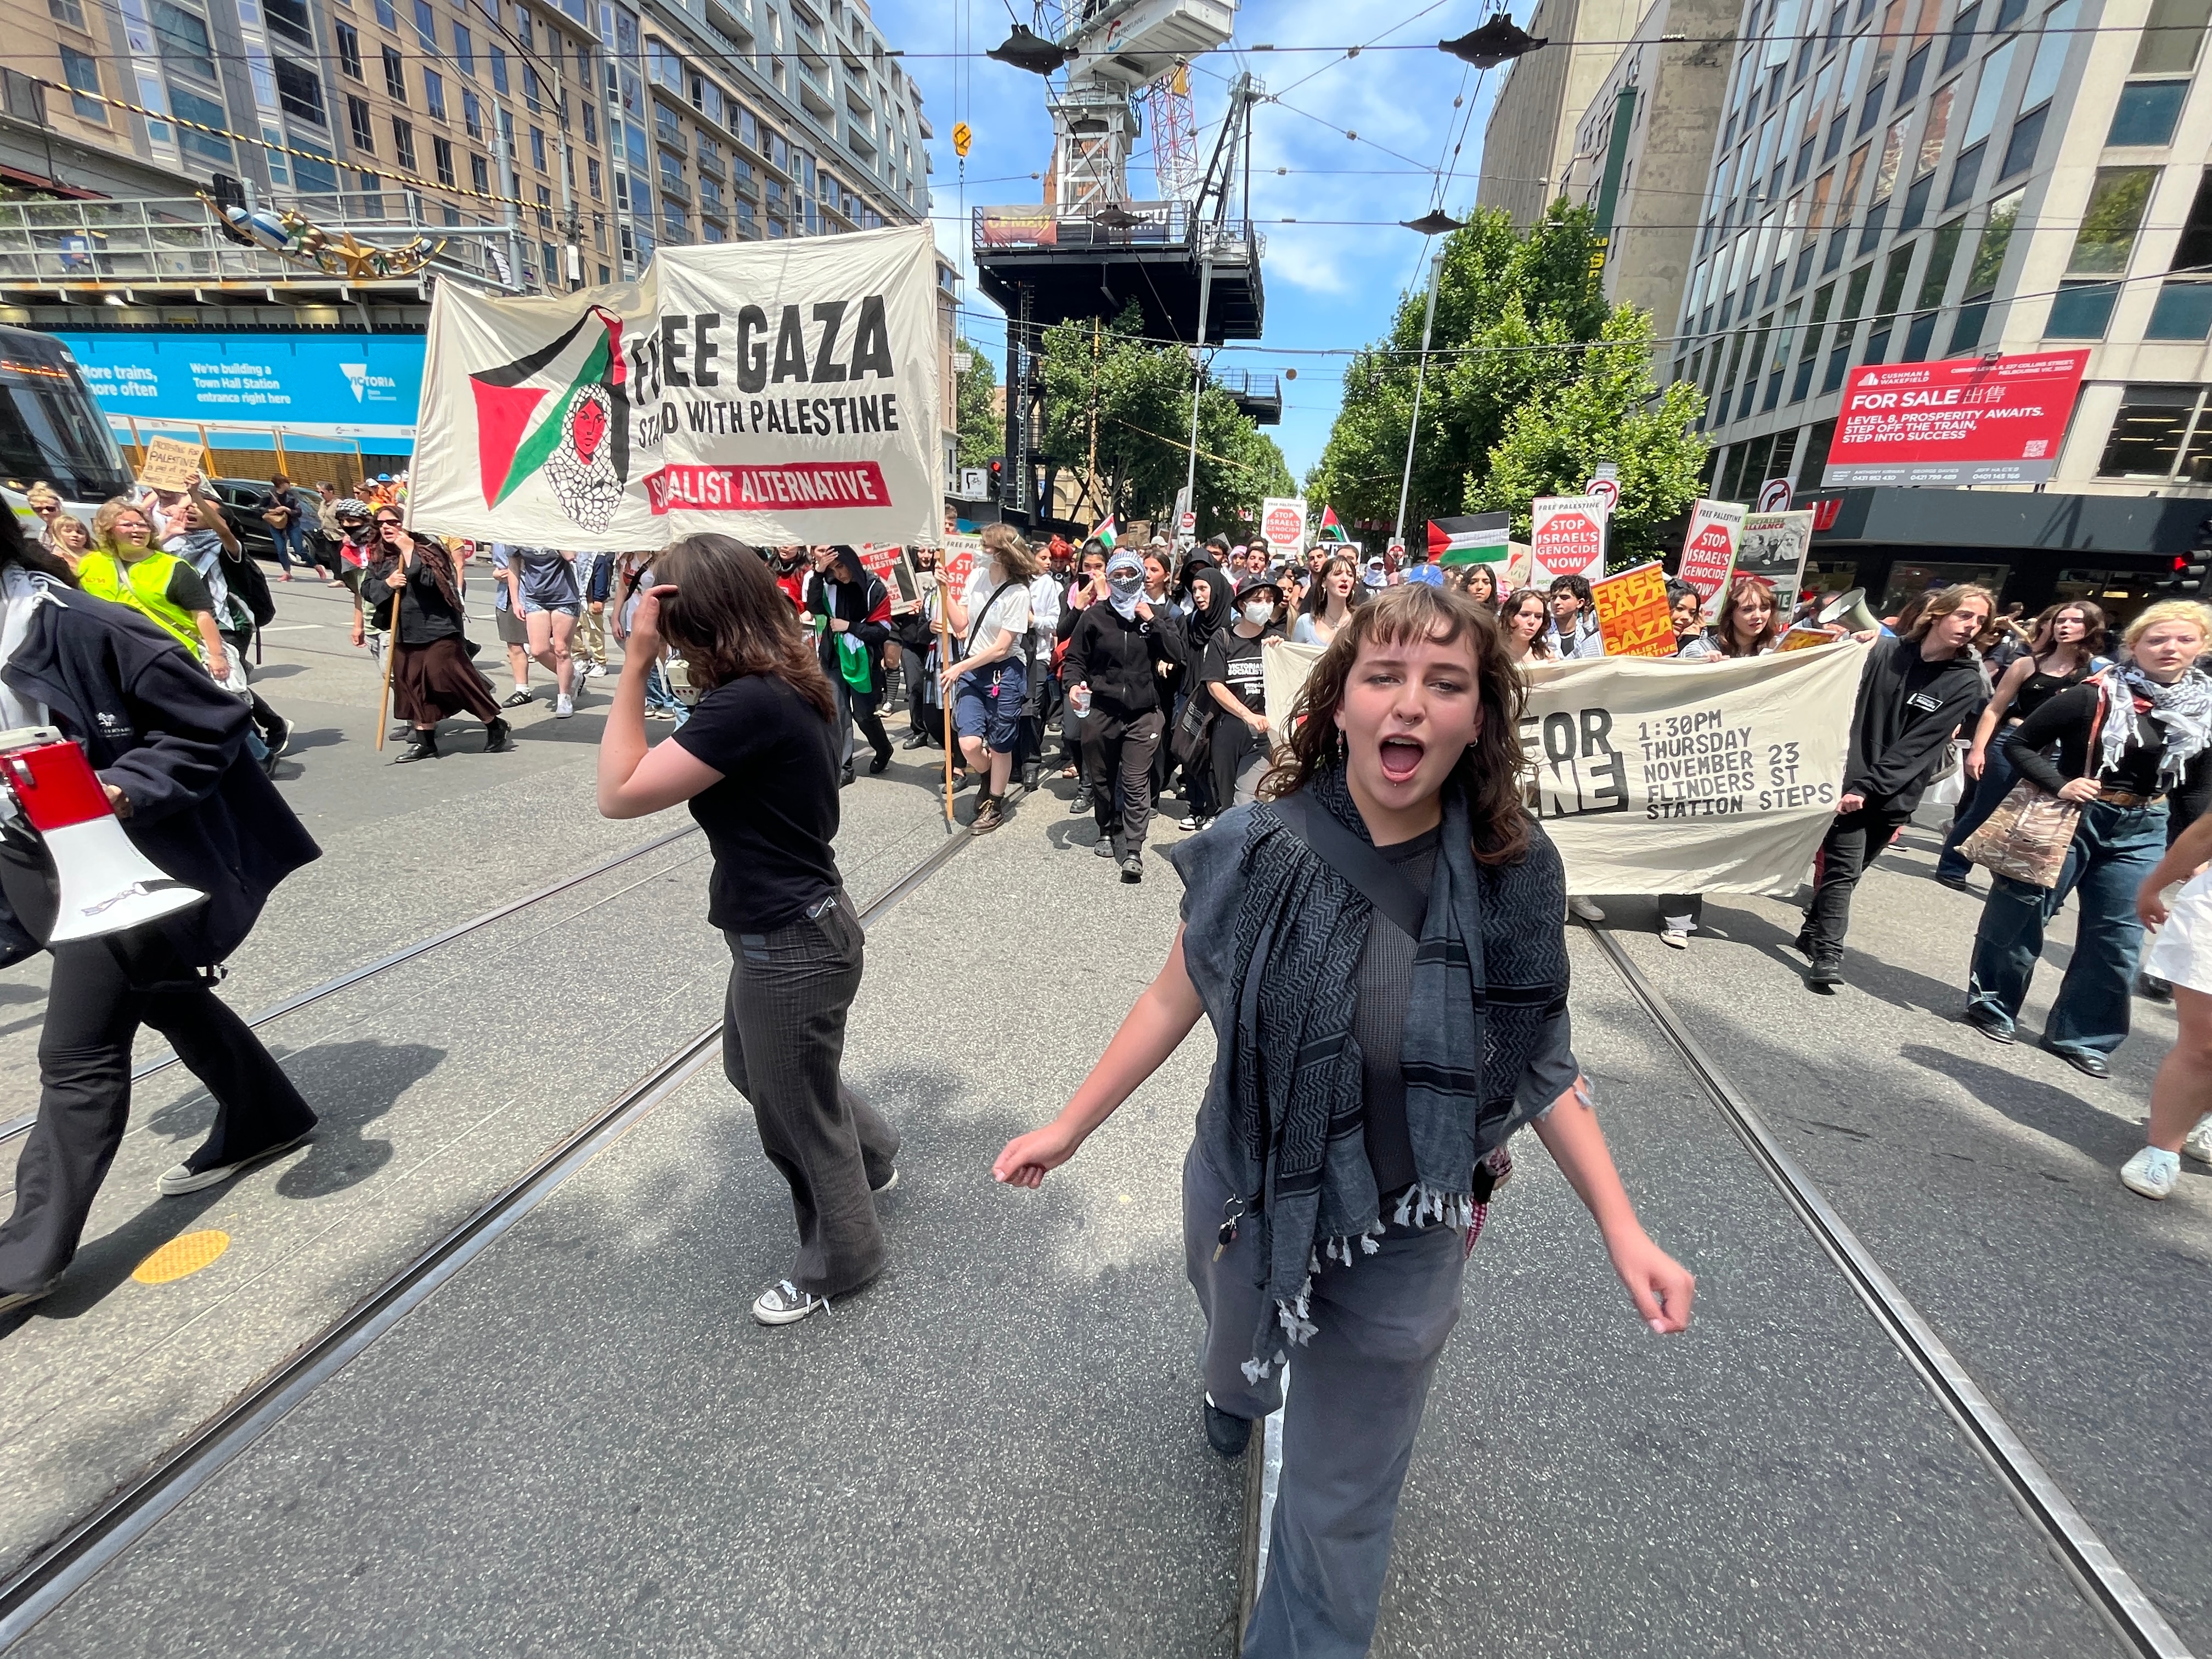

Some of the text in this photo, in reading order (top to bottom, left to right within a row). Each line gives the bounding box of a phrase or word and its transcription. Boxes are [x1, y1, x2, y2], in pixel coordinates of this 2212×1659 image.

[737, 295, 894, 393] GAZA
[114, 364, 157, 383] trains,
[189, 363, 272, 377] We're building a
[1881, 371, 1923, 380] CUSHMAN
[120, 381, 157, 397] often
[193, 377, 280, 390] Town Hall Station
[1880, 377, 1929, 385] WAKEFIELD
[196, 392, 291, 405] entrance right here
[1850, 385, 2007, 410] FOR SALE 出售
[685, 400, 746, 435] WITH
[750, 394, 899, 436] PALESTINE
[1847, 415, 1885, 426] LEVEL
[1900, 410, 1984, 422] PROSPERITY
[1984, 407, 2045, 419] AWAITS.
[1844, 420, 1977, 435] STEP OFF THE TRAIN,
[1842, 430, 1967, 443] STEP INTO SUCCESS
[149, 450, 197, 468] PALESTINE
[742, 469, 878, 503] ALTERNATIVE
[1559, 502, 1600, 510] PALESTINE
[1267, 518, 1300, 527] ISRAEL'S
[1699, 509, 1741, 523] FREE PALESTINE
[1550, 520, 1585, 531] STOP
[1537, 531, 1598, 544] ISRAEL'S
[1701, 532, 1726, 548] STOP
[869, 551, 890, 562] FREE
[1537, 544, 1598, 555] GENOCIDE
[1688, 549, 1730, 566] ISRAEL'S
[1547, 557, 1587, 569] NOW!
[1684, 565, 1726, 580] GENOCIDE
[1592, 566, 1663, 606] FREE
[1596, 580, 1667, 623] GAZA
[1601, 601, 1671, 638] FREE
[1604, 614, 1672, 656] GAZA
[1638, 709, 1722, 741] 1:30PM
[1519, 708, 1613, 761] FOR
[1640, 726, 1752, 761] THURSDAY
[1643, 742, 1799, 783] NOVEMBER 23
[1647, 764, 1799, 803] FLINDERS ST
[1646, 782, 1833, 820] STATION STEPS
